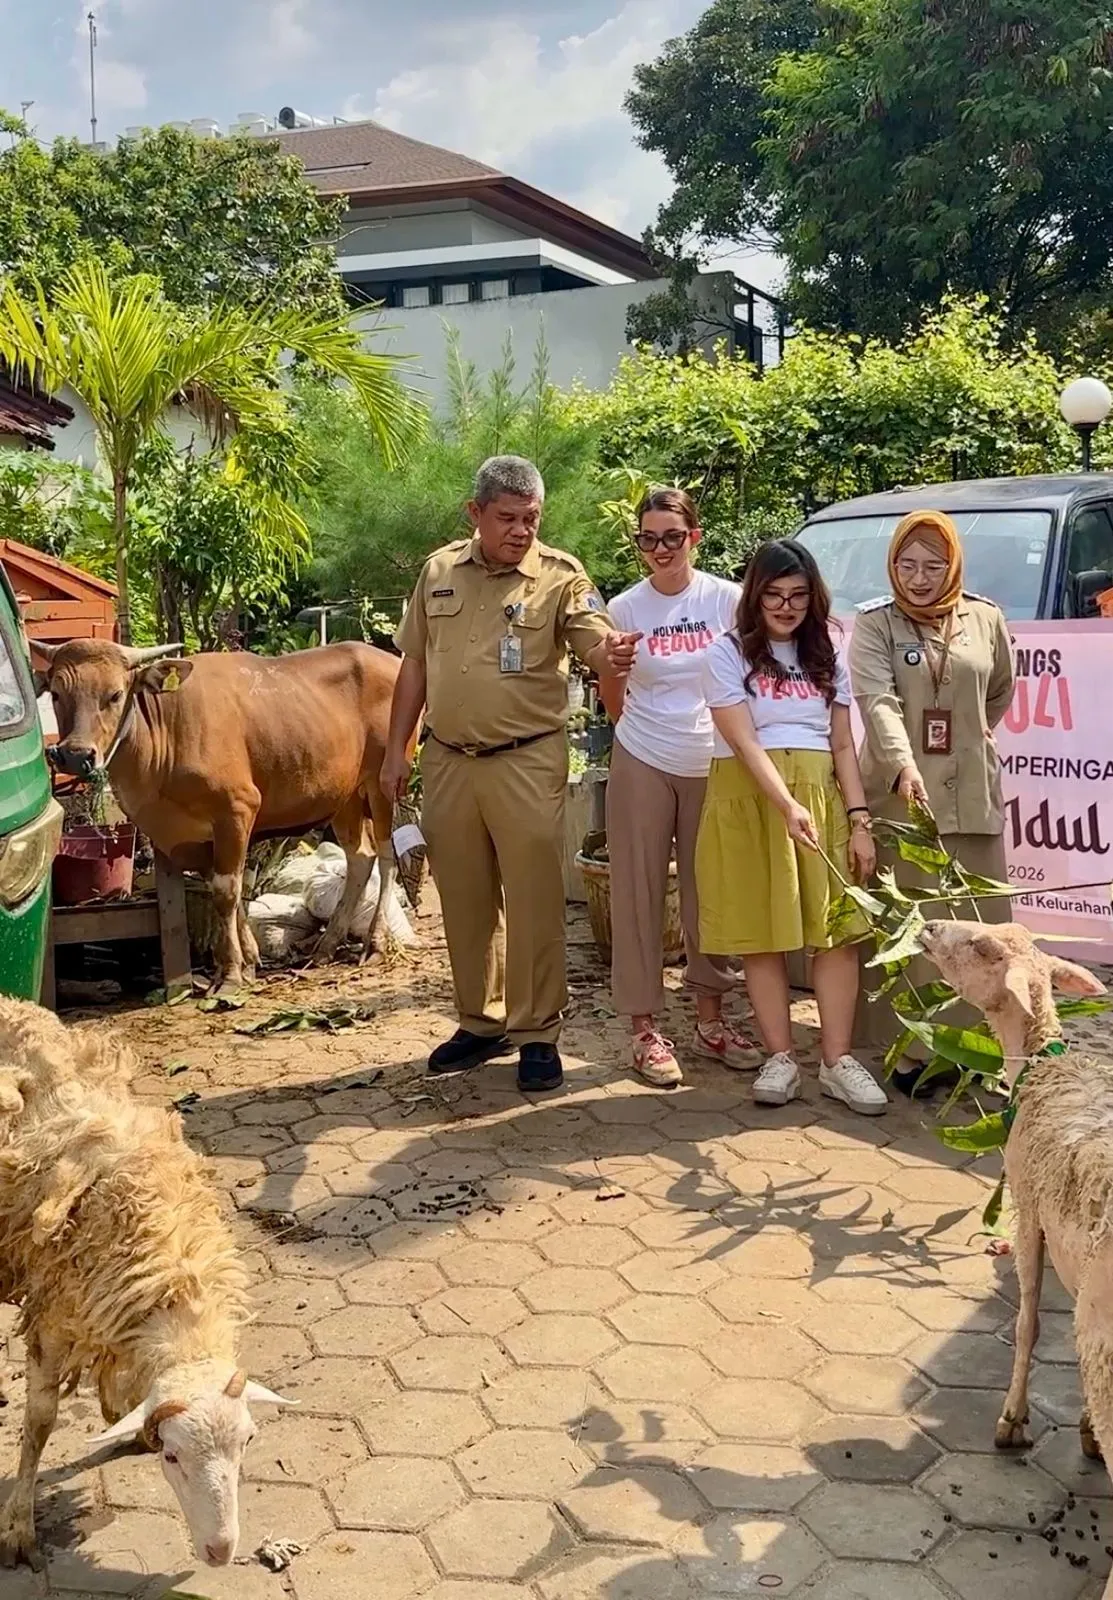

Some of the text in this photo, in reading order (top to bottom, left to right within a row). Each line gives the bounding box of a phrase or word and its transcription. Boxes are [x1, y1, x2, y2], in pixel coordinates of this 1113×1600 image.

[653, 621, 707, 637] HOLYWINGS
[647, 630, 713, 656] PEDULI
[1012, 649, 1061, 677] NGS
[757, 676, 823, 699] PEDUL
[1008, 865, 1045, 881] 2026
[1020, 894, 1034, 907] di
[1036, 895, 1111, 916] Kelurahan
